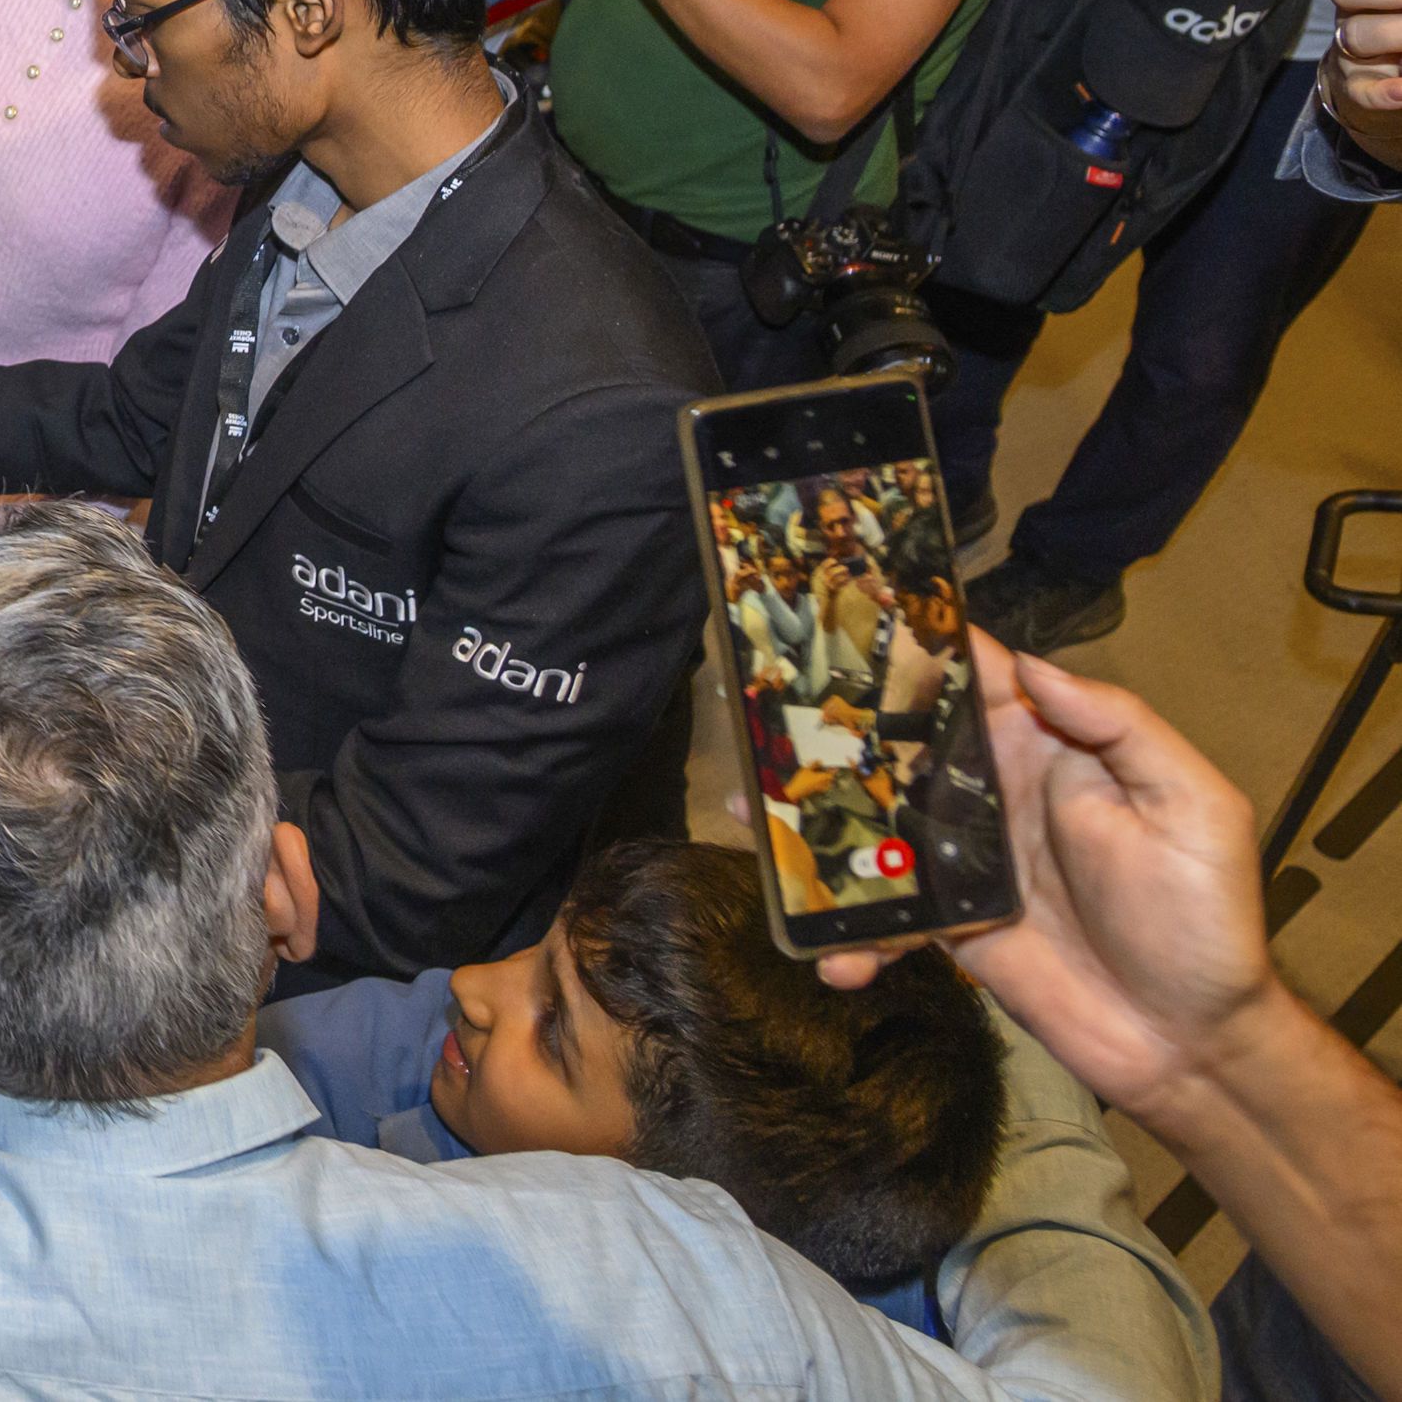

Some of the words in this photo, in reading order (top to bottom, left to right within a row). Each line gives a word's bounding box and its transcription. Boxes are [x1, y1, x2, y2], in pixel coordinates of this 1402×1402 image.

[292, 554, 417, 623] adani
[299, 597, 404, 645] Sportsline
[452, 626, 588, 704] adani
